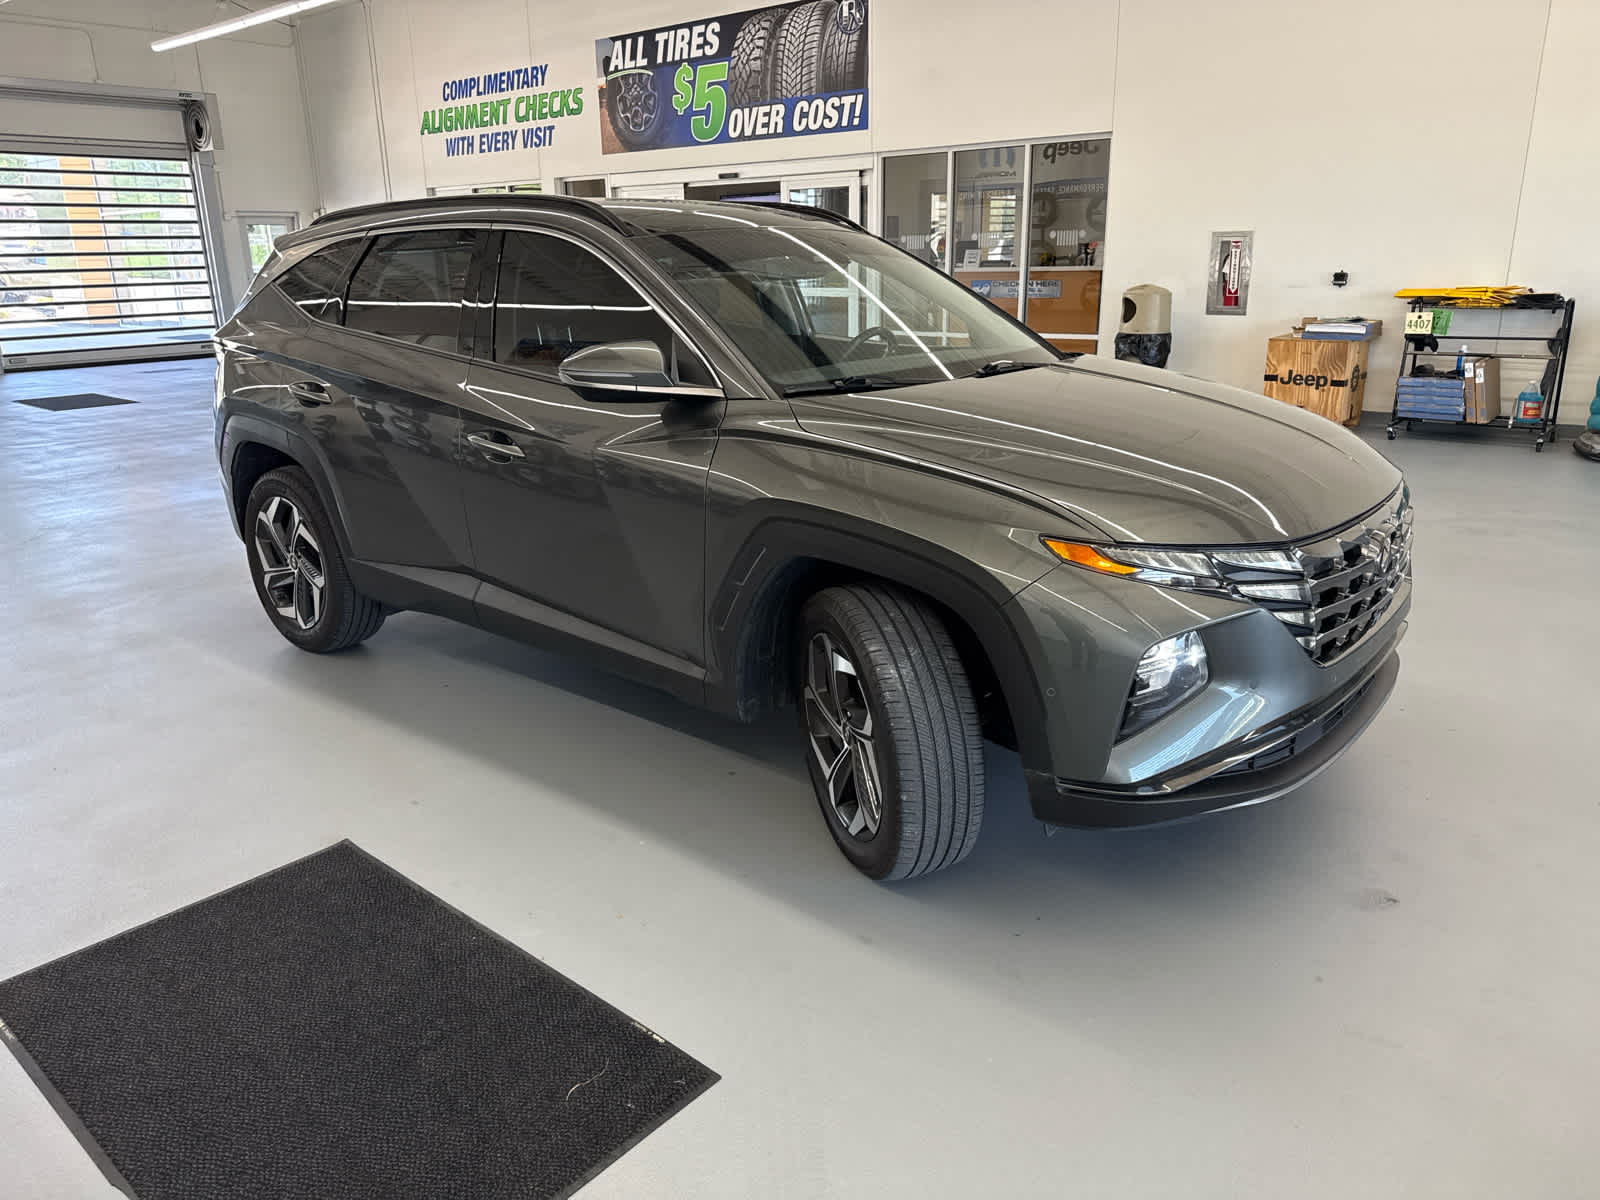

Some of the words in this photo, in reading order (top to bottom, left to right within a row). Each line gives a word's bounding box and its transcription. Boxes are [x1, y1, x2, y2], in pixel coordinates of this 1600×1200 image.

[609, 35, 648, 72] ALL
[655, 21, 720, 64] TIRES
[442, 64, 548, 102] COMPLIMENTARY
[672, 61, 728, 142] $5
[420, 97, 511, 136] ALIGNMENT
[514, 87, 583, 121] CHECKS
[728, 103, 783, 139] OVER
[792, 94, 864, 133] COST!
[445, 132, 475, 158] WITH
[479, 128, 517, 154] EVERY
[522, 124, 555, 149] VISIT
[1406, 319, 1431, 330] 4407
[1279, 369, 1328, 390] Jeep
